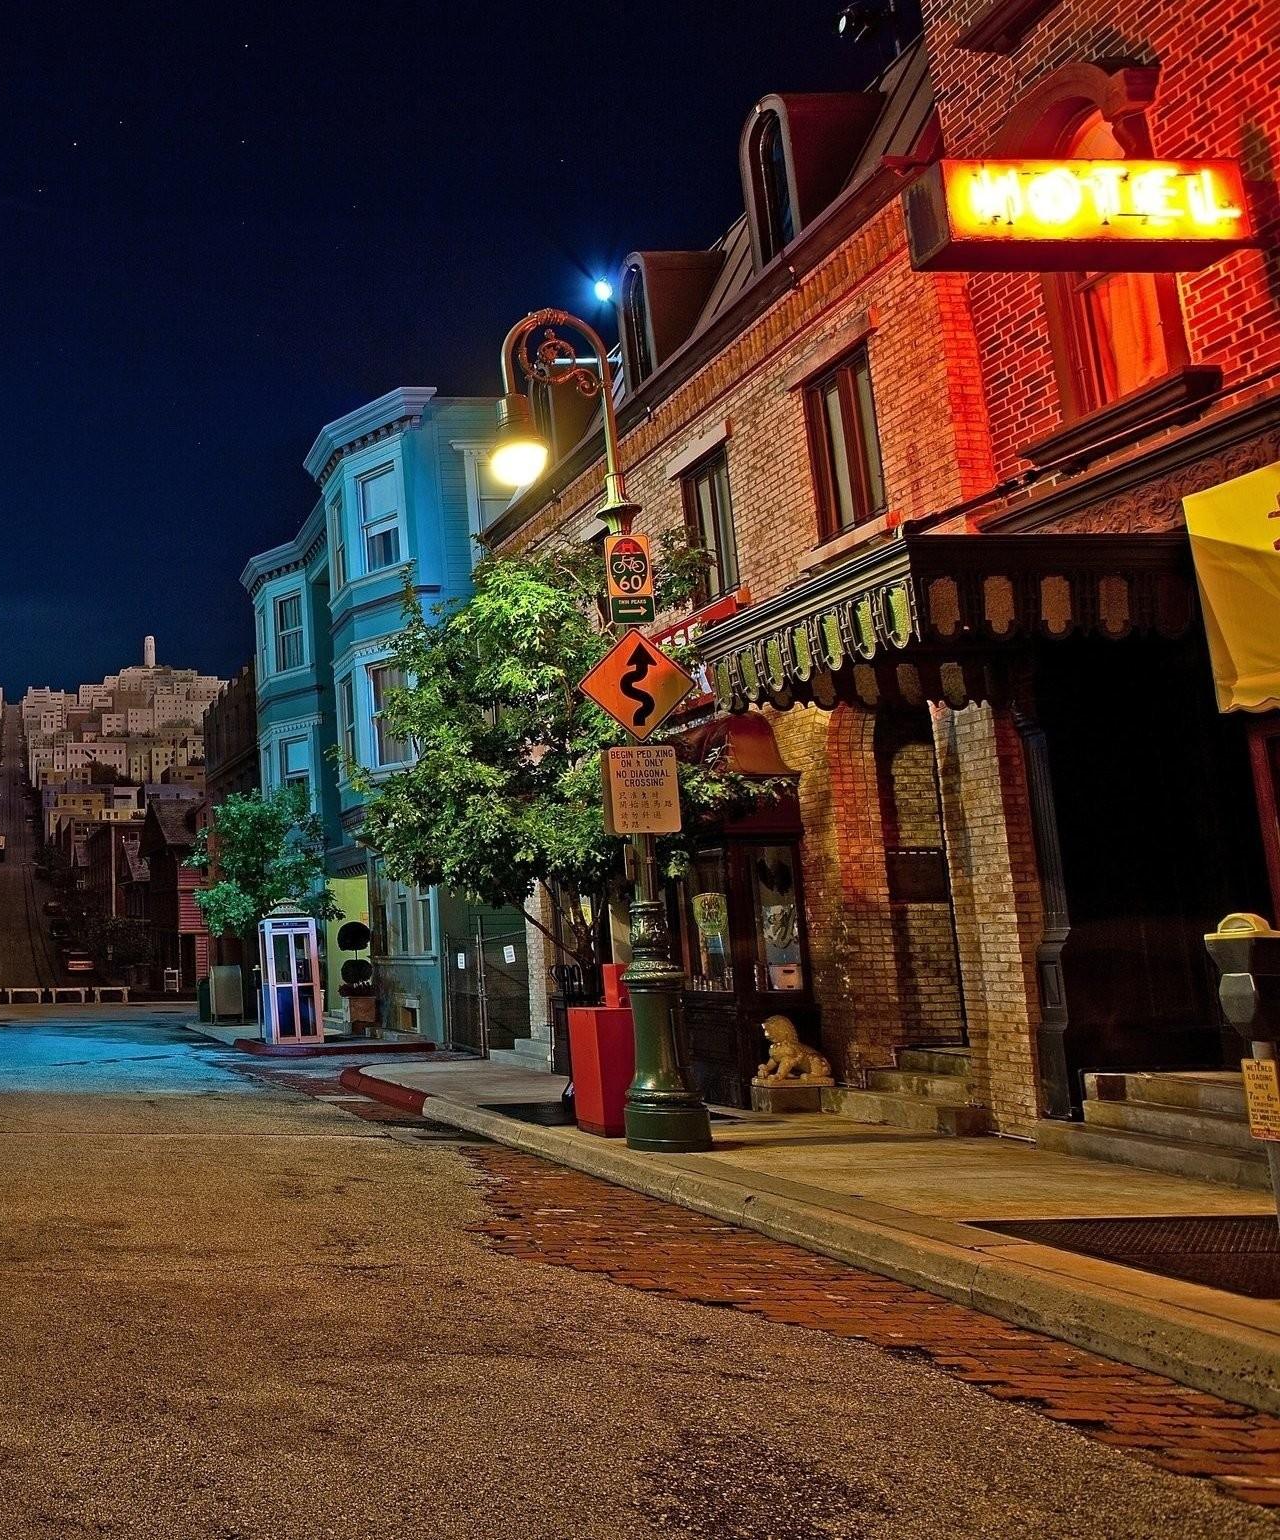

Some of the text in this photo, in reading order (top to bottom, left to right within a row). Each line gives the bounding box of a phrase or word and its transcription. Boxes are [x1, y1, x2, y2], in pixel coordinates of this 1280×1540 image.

[619, 575, 642, 591] 60
[611, 749, 673, 759] BEGIN PED XING
[621, 759, 664, 768] ON ONLY
[616, 769, 671, 779] NO DIAGONAL
[624, 778, 664, 787] CROSSING
[1245, 1064, 1273, 1073] METERED
[1247, 1073, 1273, 1082] LOADING
[1253, 1082, 1269, 1090] ONLY
